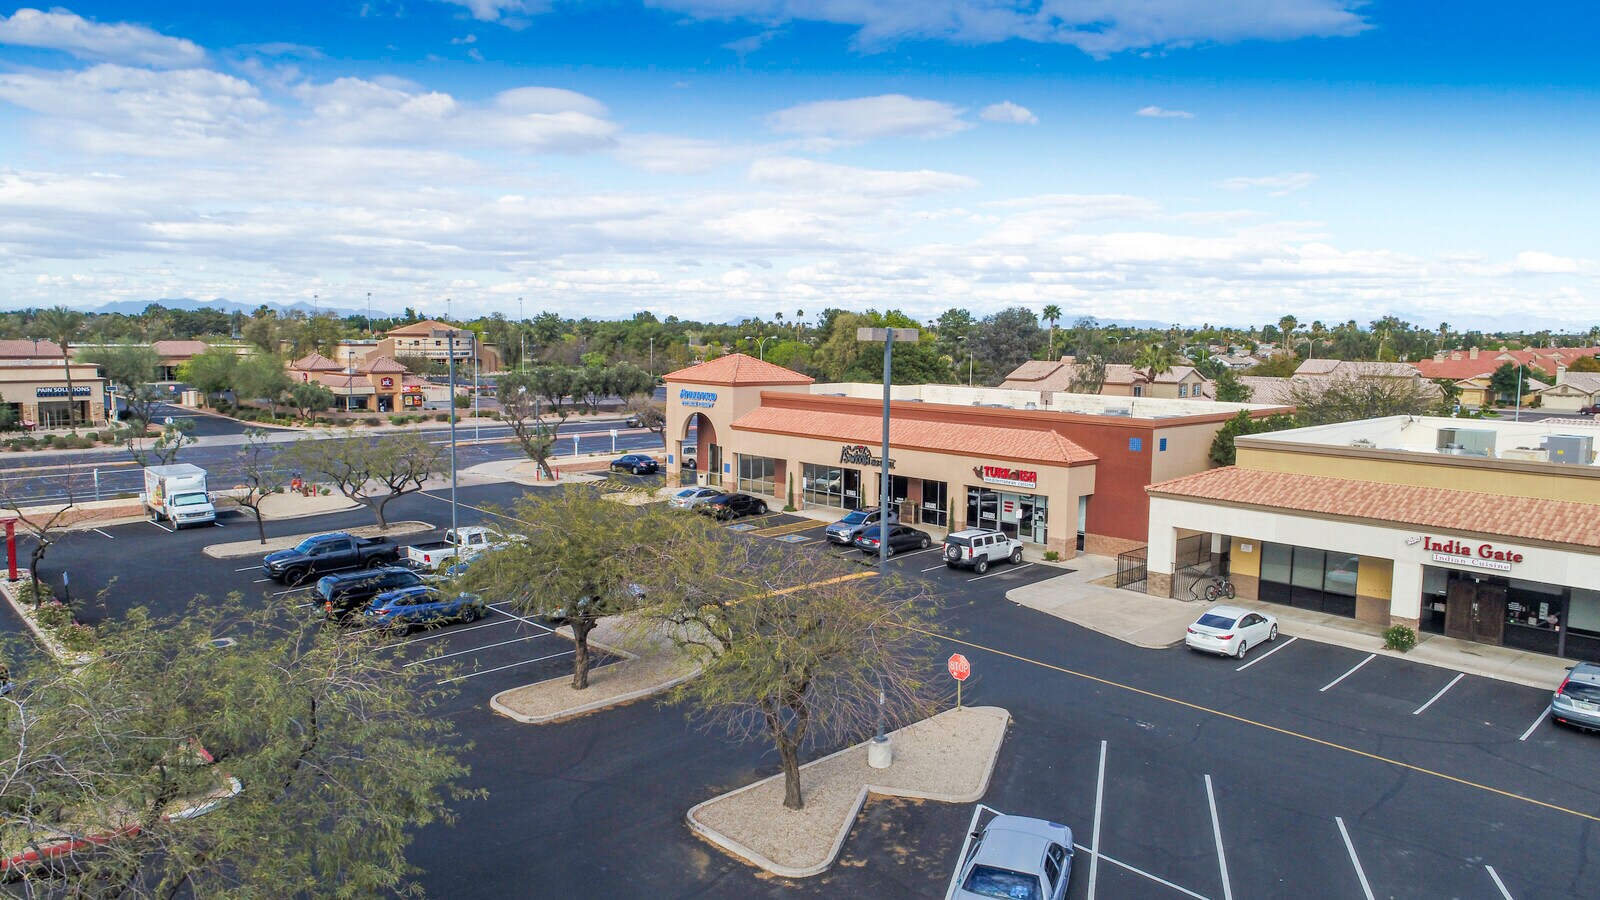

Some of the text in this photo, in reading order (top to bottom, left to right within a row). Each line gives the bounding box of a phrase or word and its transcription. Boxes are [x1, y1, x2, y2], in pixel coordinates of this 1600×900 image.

[680, 389, 717, 401] ATHLETICO
[1423, 536, 1523, 563] India Gate
[1435, 554, 1466, 564] Indian
[950, 660, 969, 673] STOP
